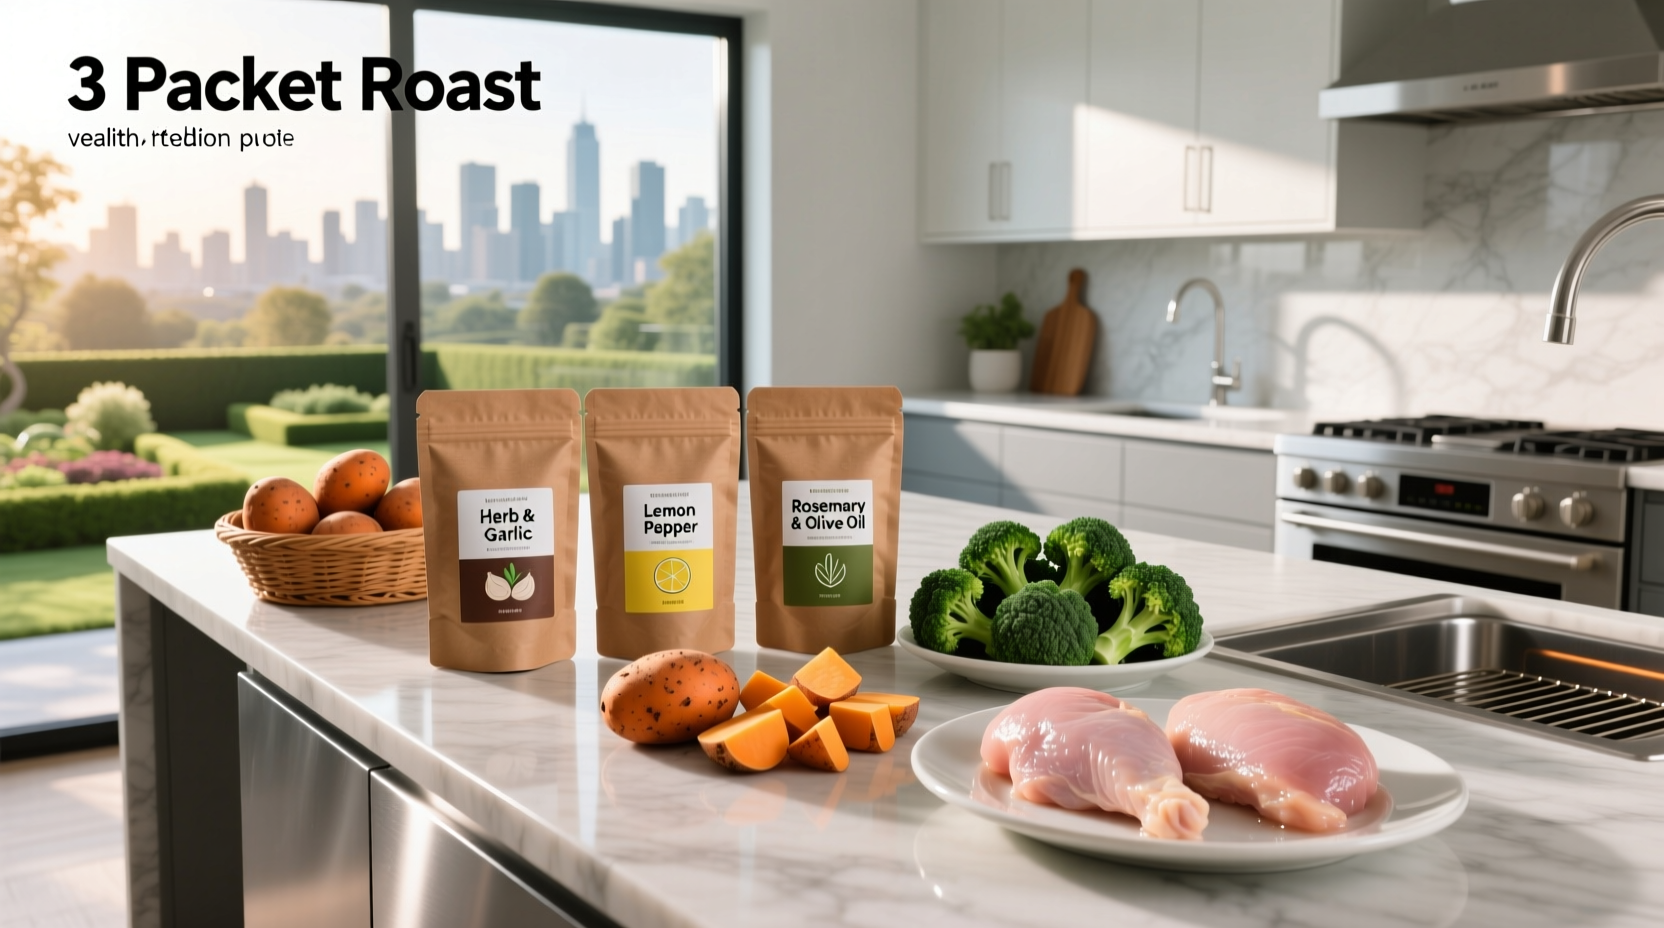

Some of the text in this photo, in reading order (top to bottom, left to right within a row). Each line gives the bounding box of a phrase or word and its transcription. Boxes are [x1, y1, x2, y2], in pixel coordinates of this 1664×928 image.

[644, 504, 696, 518] Lemon
[792, 499, 865, 514] Rosemary
[480, 507, 535, 524] Herb &
[791, 515, 865, 530] & Olive Oil
[484, 525, 533, 542] Garlic
[644, 520, 699, 538] Pepper
